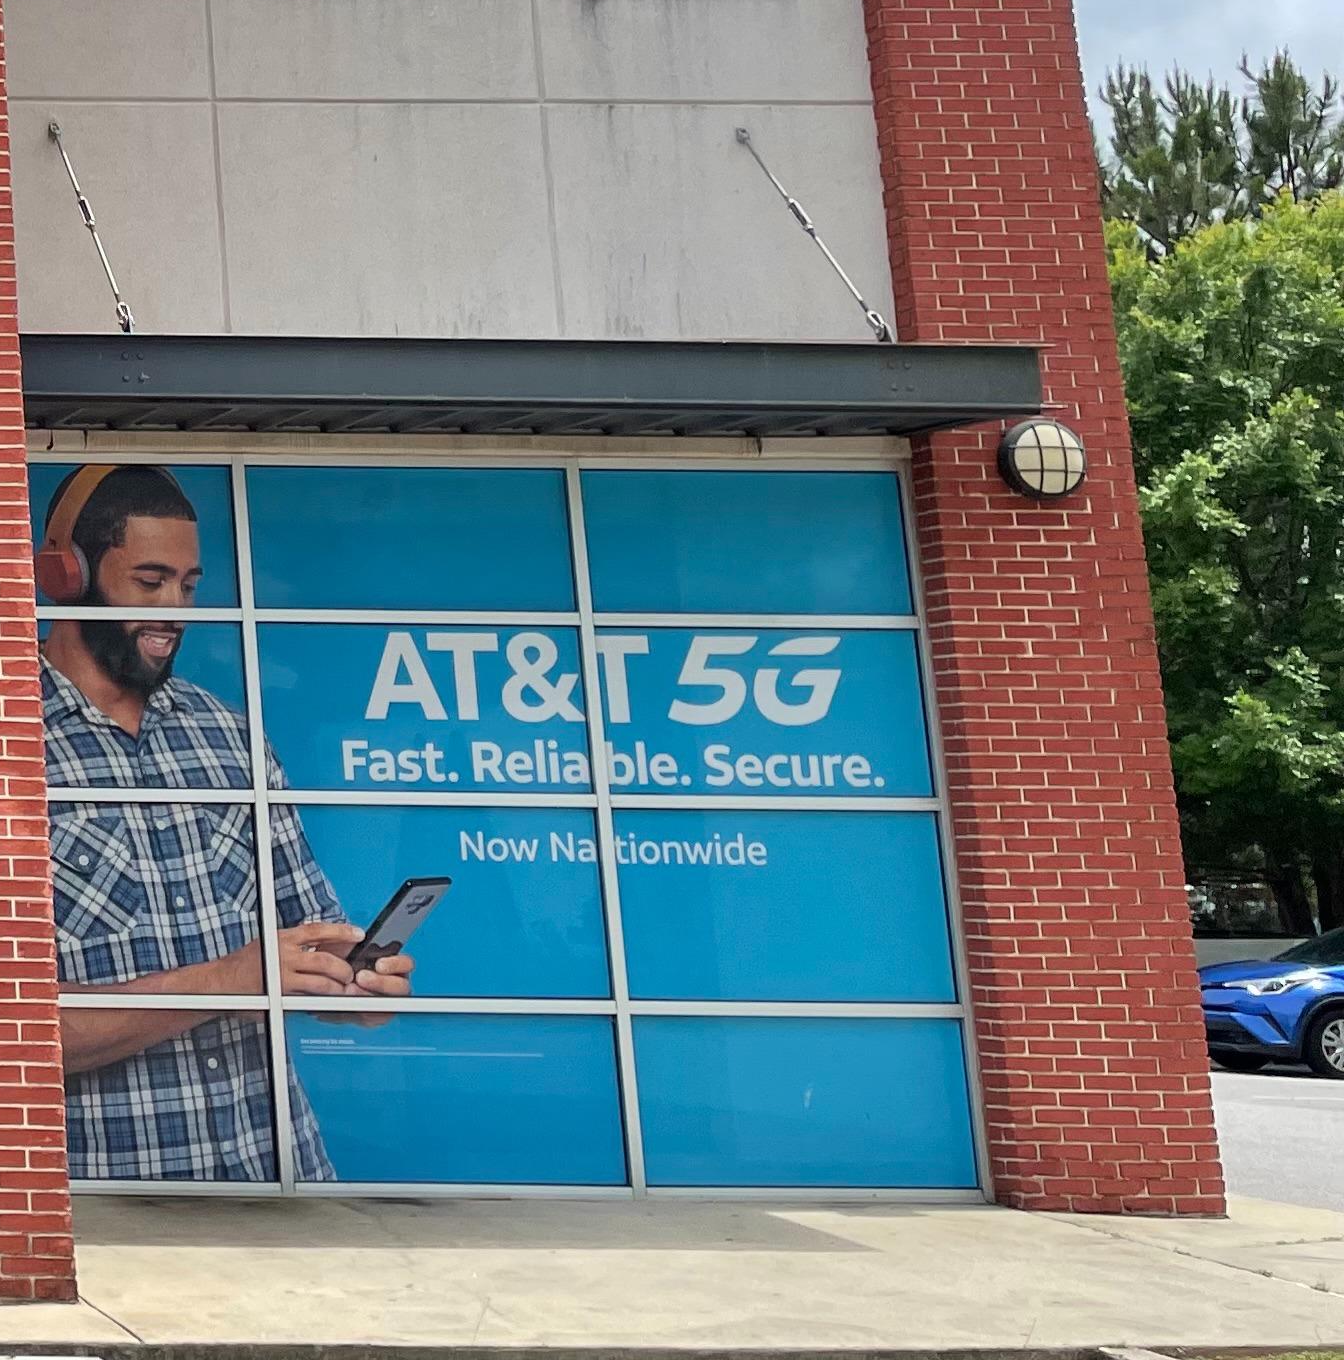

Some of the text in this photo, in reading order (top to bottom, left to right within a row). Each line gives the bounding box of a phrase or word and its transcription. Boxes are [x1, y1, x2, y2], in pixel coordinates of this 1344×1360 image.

[364, 631, 843, 726] AT&T 5G
[342, 740, 886, 788] Fast. Reliable. Secure.
[459, 831, 769, 867] Now Nationwide
